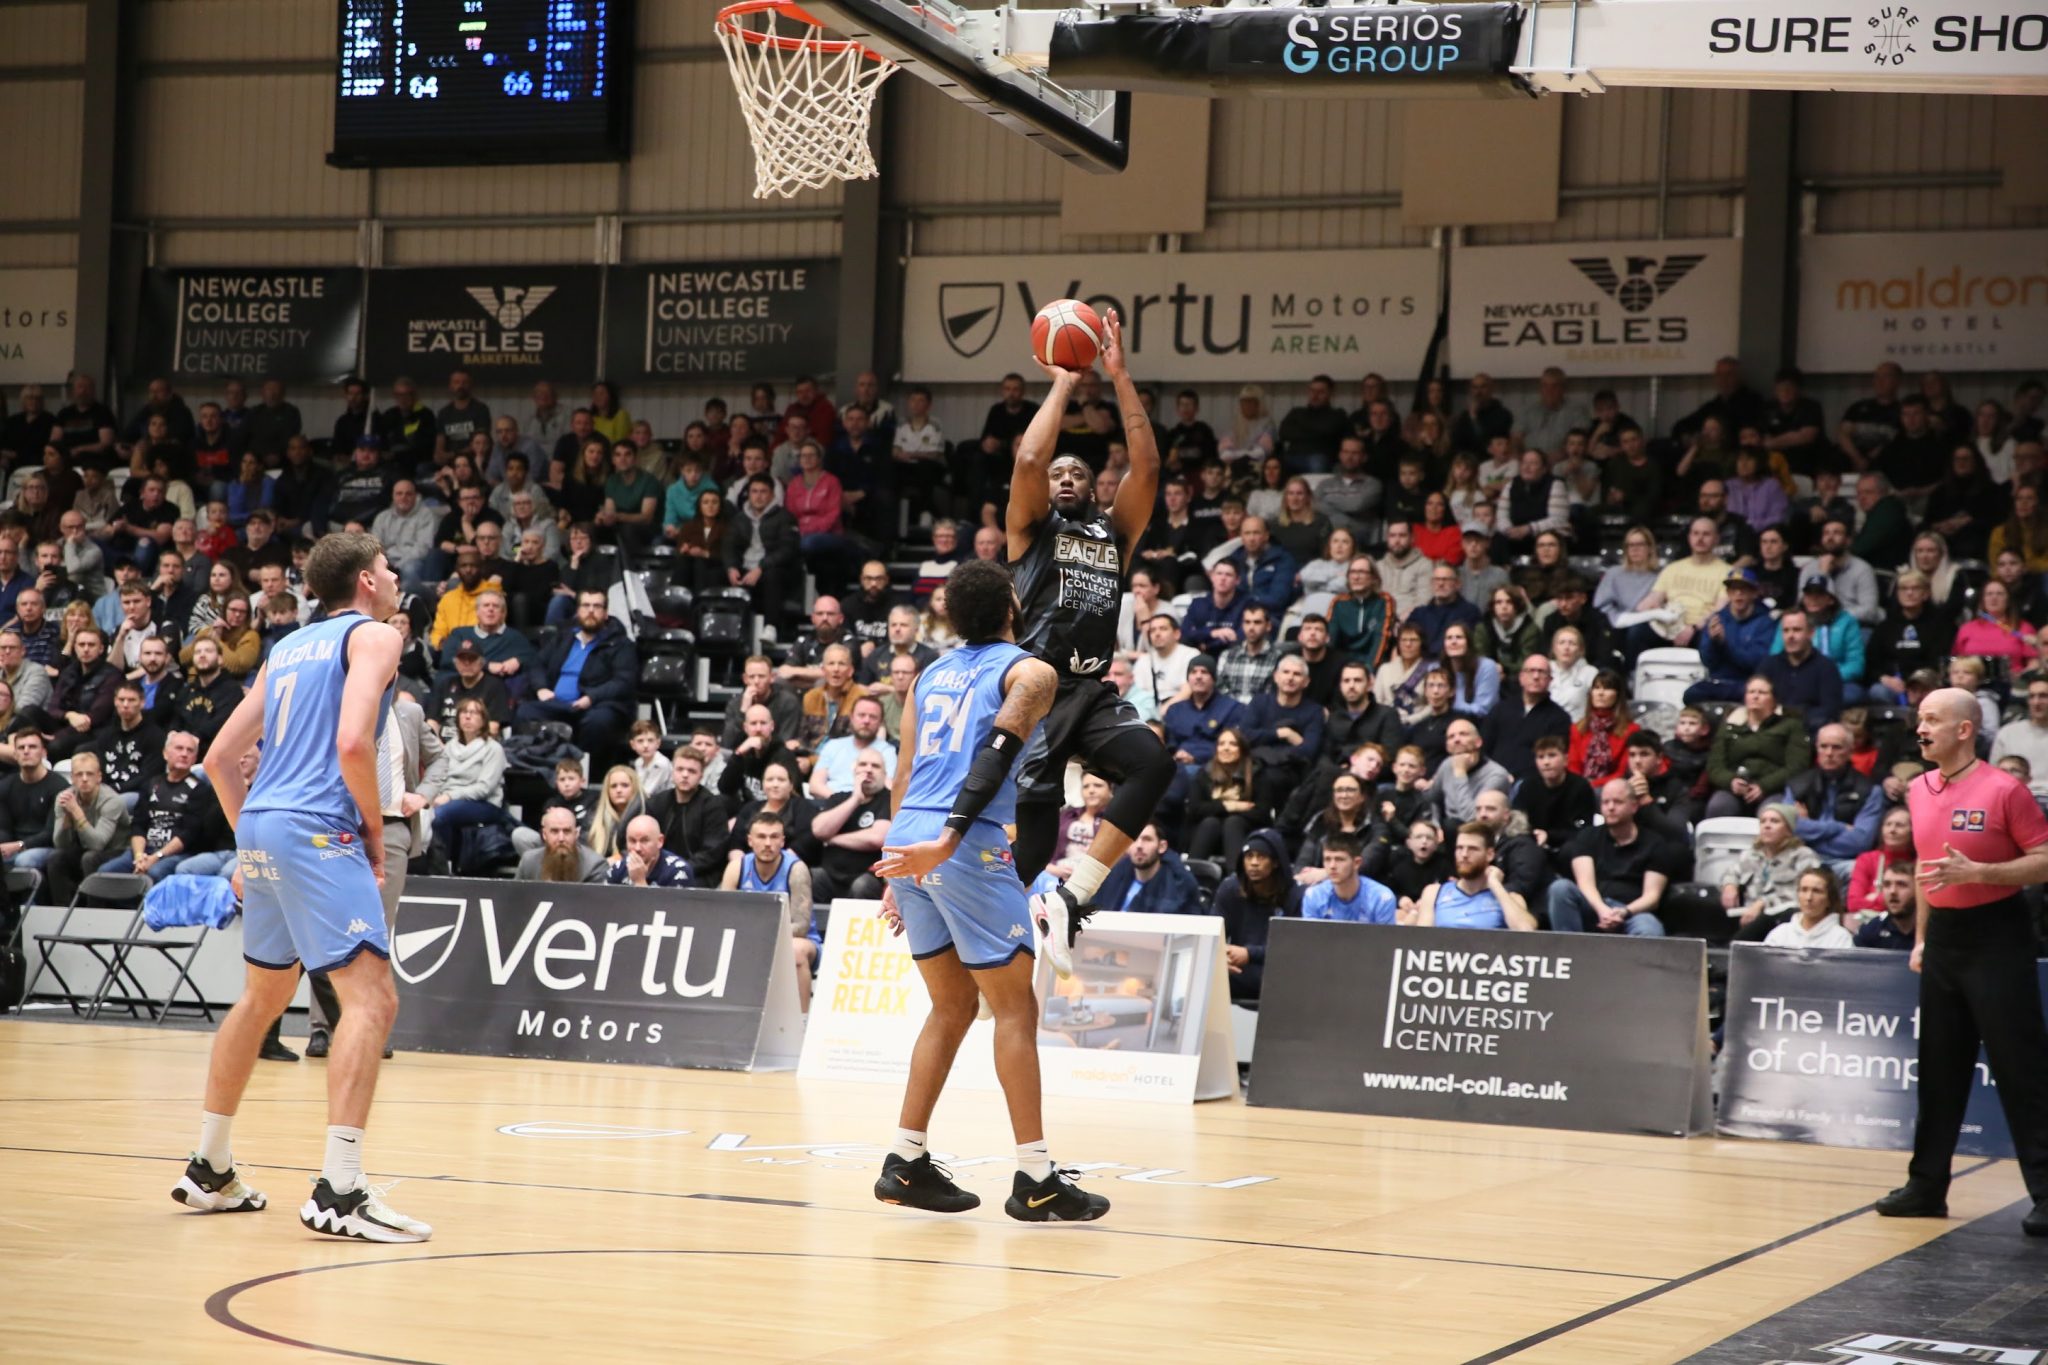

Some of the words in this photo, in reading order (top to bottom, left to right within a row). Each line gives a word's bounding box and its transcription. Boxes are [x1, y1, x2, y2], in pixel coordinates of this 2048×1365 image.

[1328, 14, 1463, 42] SERIOS
[1867, 6, 1919, 29] SURE
[1709, 17, 1852, 53] SURE
[1327, 45, 1460, 73] GROUP
[1863, 42, 1917, 66] SHOT
[410, 74, 439, 98] 64
[504, 71, 534, 95] 66
[189, 277, 325, 298] NEWCASTLE
[659, 268, 807, 294] NEWCASTLE
[1836, 264, 2048, 310] maldron
[187, 302, 291, 323] COLLEGE
[658, 297, 770, 321] COLLEGE
[1271, 293, 1415, 316] Motors
[1484, 302, 1599, 318] NEWCASTLE
[408, 320, 487, 332] NEWCASTLE
[657, 323, 793, 347] UNIVERSITY
[1483, 317, 1689, 347] EAGLES
[1883, 315, 2003, 332] HOTEL
[186, 328, 312, 348] UNIVERSITY
[407, 331, 544, 353] EAGLES
[1271, 335, 1360, 354] ARENA
[1885, 342, 1999, 355] NEWCASTLE
[183, 354, 268, 374] CENTRE
[462, 353, 542, 365] BASKETBALL
[655, 350, 747, 373] CENTRE
[1566, 347, 1686, 362] BASKETBALL
[1054, 534, 1119, 573] EAGLE
[1064, 589, 1116, 609] UNIVERSIT
[1065, 578, 1112, 598] COLLEGE
[1064, 599, 1104, 617] CENTRE
[274, 671, 298, 747] 7
[845, 917, 890, 948] EAT
[480, 898, 736, 998] Vertu
[838, 952, 912, 983] SLEEP
[1406, 949, 1573, 980] NEWCASTLE
[832, 984, 912, 1016] RELAX
[1402, 976, 1530, 1004] COLLEGE
[516, 1009, 664, 1045] Motors
[1400, 1003, 1554, 1031] UNIVERSITY
[1751, 997, 1823, 1034] The
[1837, 1001, 1901, 1038] law
[1396, 1030, 1500, 1056] CENTRE
[1747, 1038, 1789, 1072] of
[1134, 1074, 1176, 1086] HOTEL
[1363, 1072, 1569, 1101] www.ncl-coll.ac.uk
